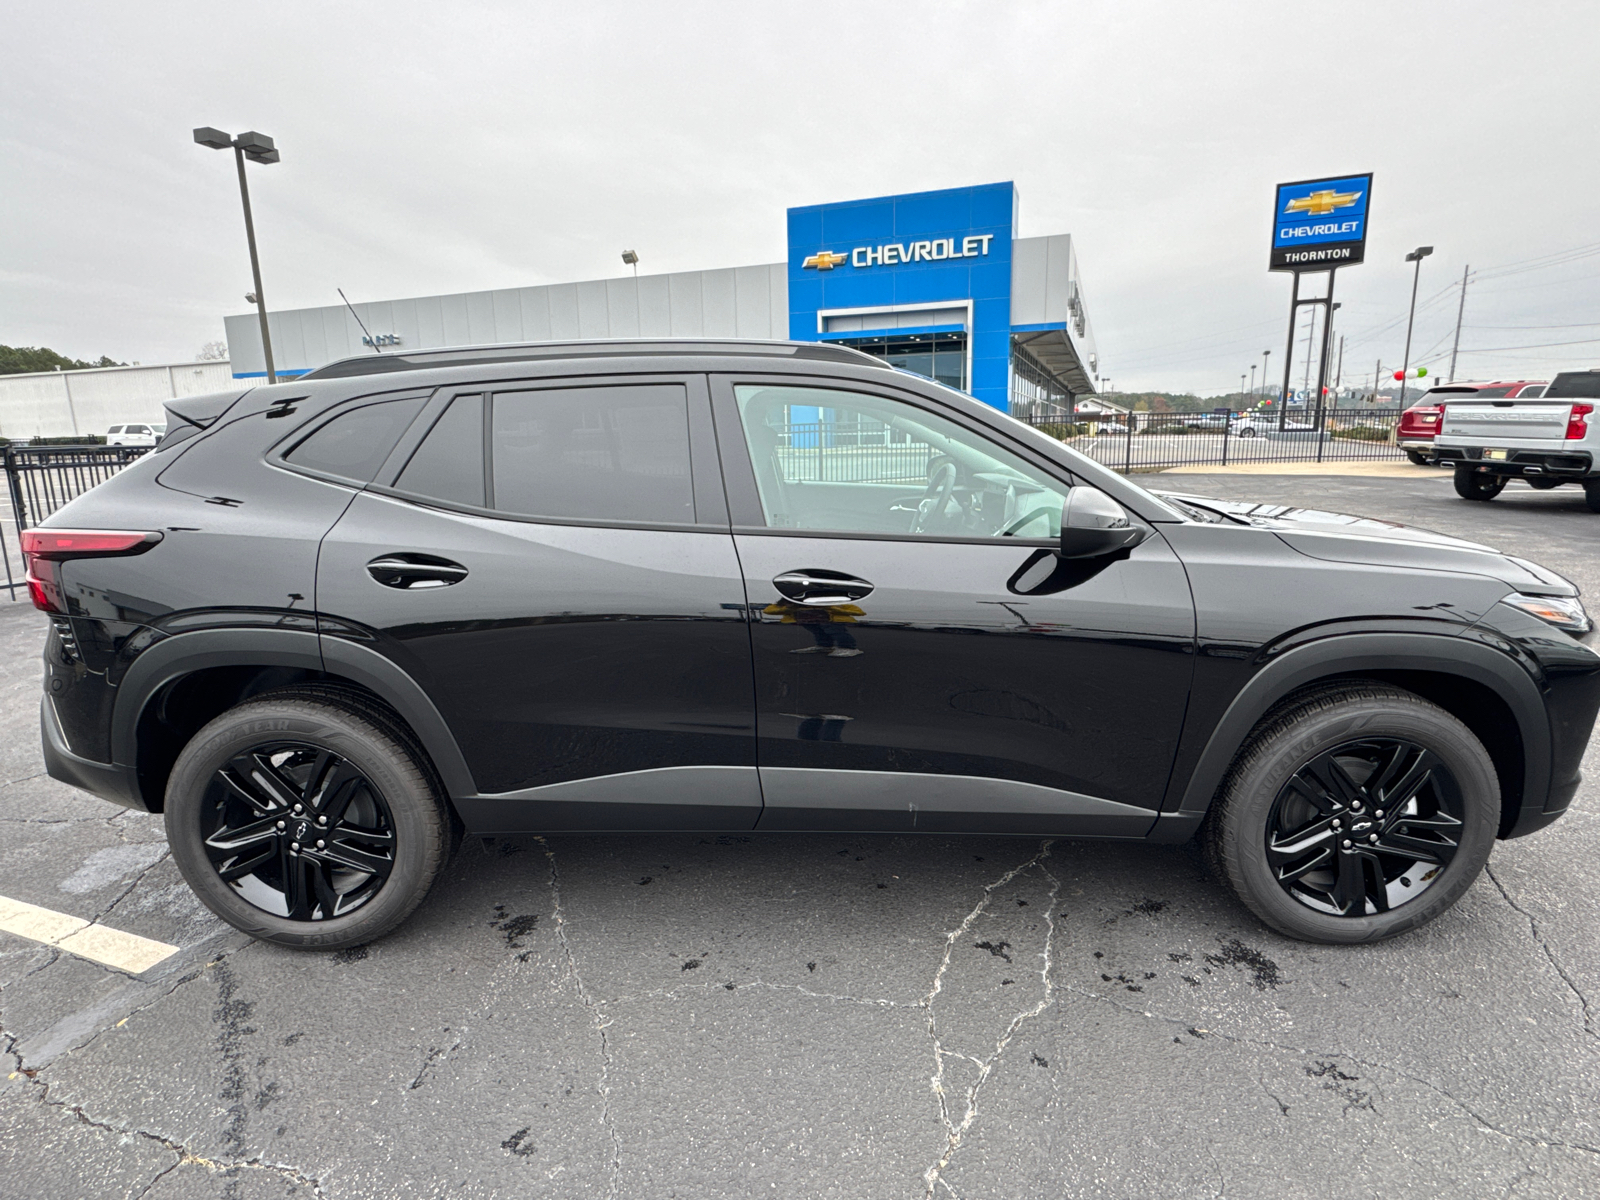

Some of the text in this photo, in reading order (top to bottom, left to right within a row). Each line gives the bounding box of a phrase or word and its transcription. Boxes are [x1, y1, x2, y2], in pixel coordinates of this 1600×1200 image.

[1280, 221, 1359, 239] CHEVROLET
[852, 234, 994, 267] CHEVROLET
[1285, 248, 1350, 262] THORNTON
[1450, 412, 1560, 422] CHEVROLET
